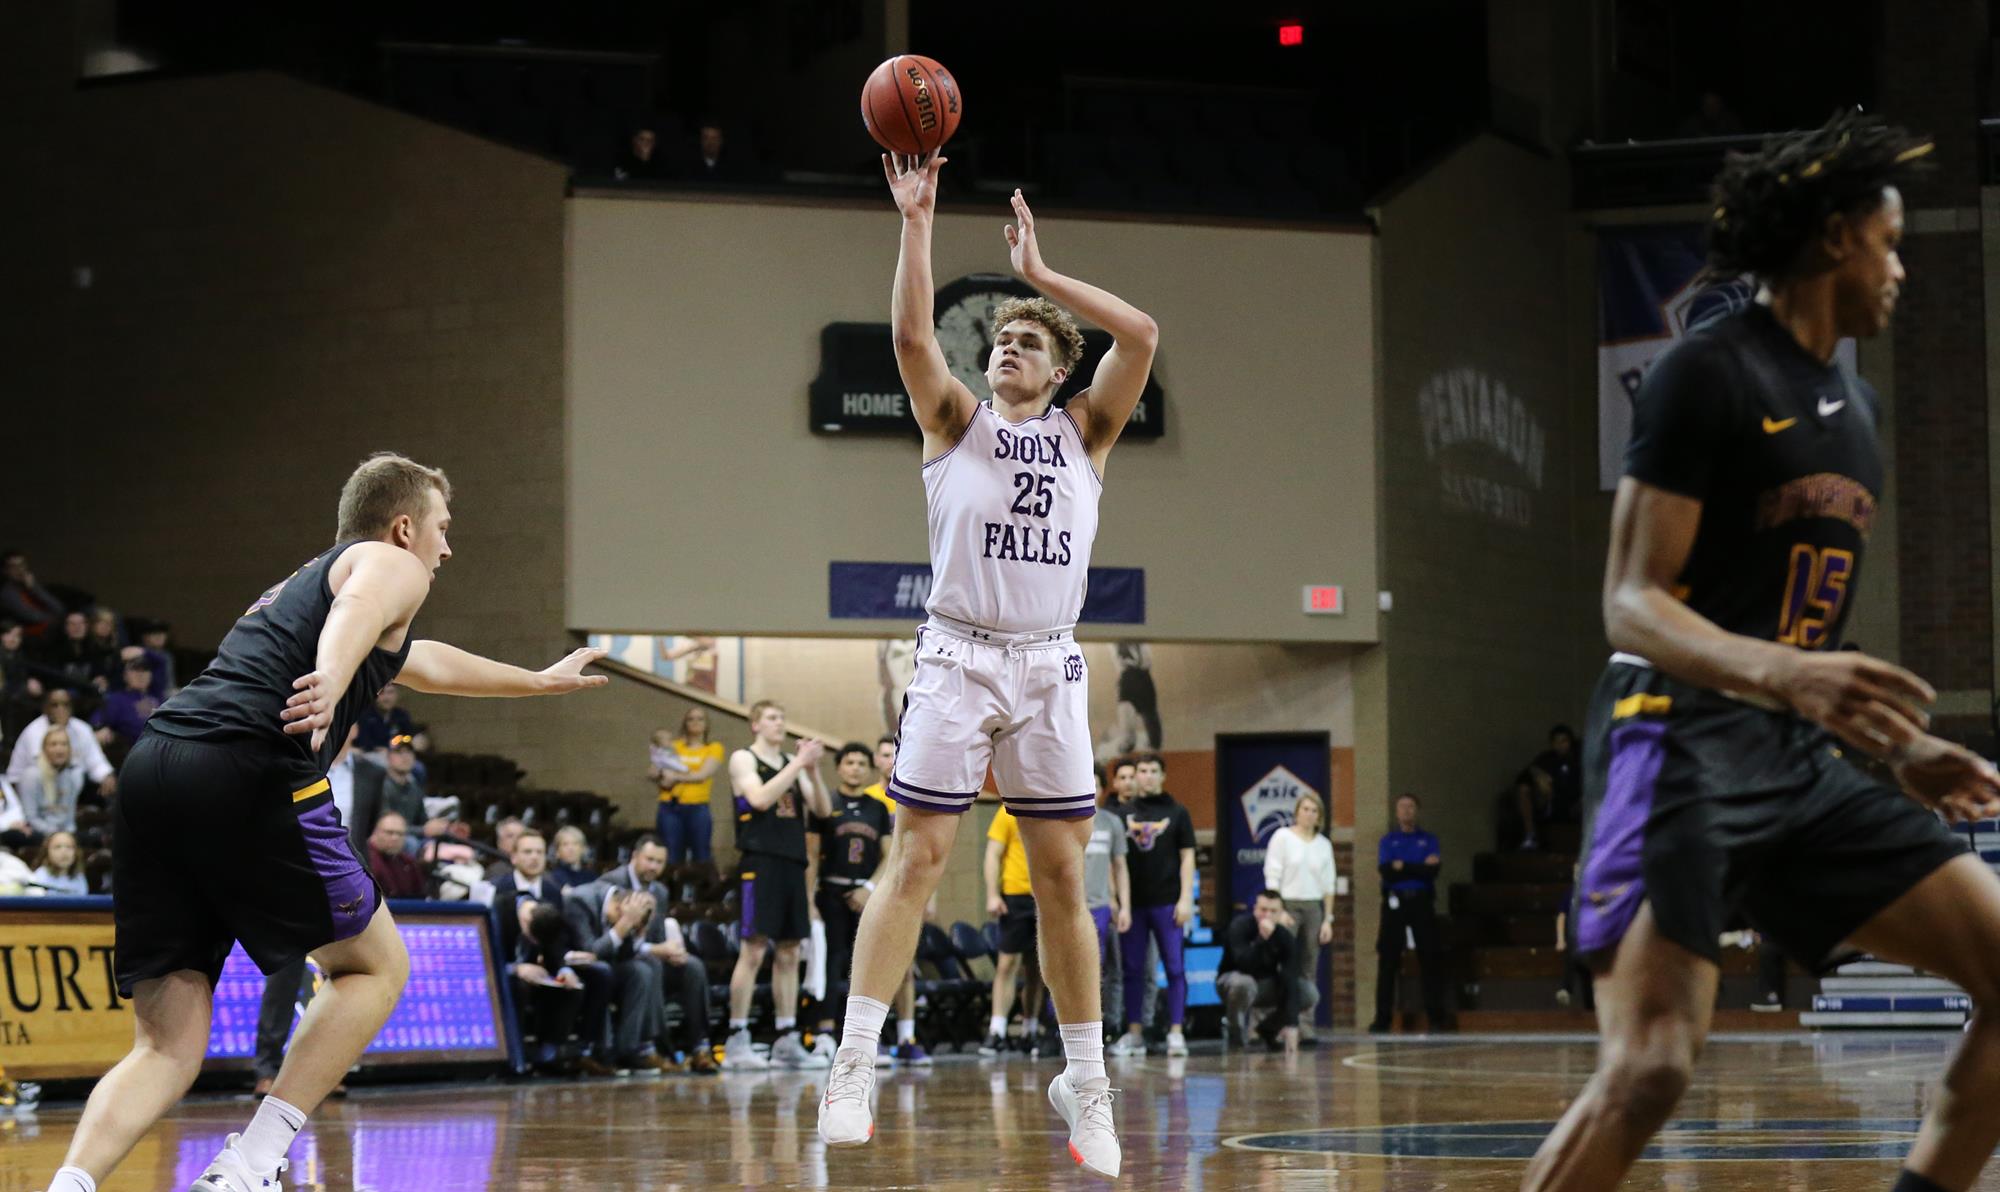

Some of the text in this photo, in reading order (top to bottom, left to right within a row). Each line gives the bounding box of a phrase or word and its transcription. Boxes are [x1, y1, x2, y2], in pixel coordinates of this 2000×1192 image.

[906, 66, 937, 133] Wilson
[843, 392, 904, 417] HOME
[994, 428, 1067, 467] SIOUX
[1011, 472, 1056, 519] 25
[983, 522, 1071, 566] FALLS
[1778, 543, 1854, 649] 15
[1064, 664, 1083, 682] USF
[1259, 785, 1299, 799] NSIC
[848, 838, 864, 864] 2
